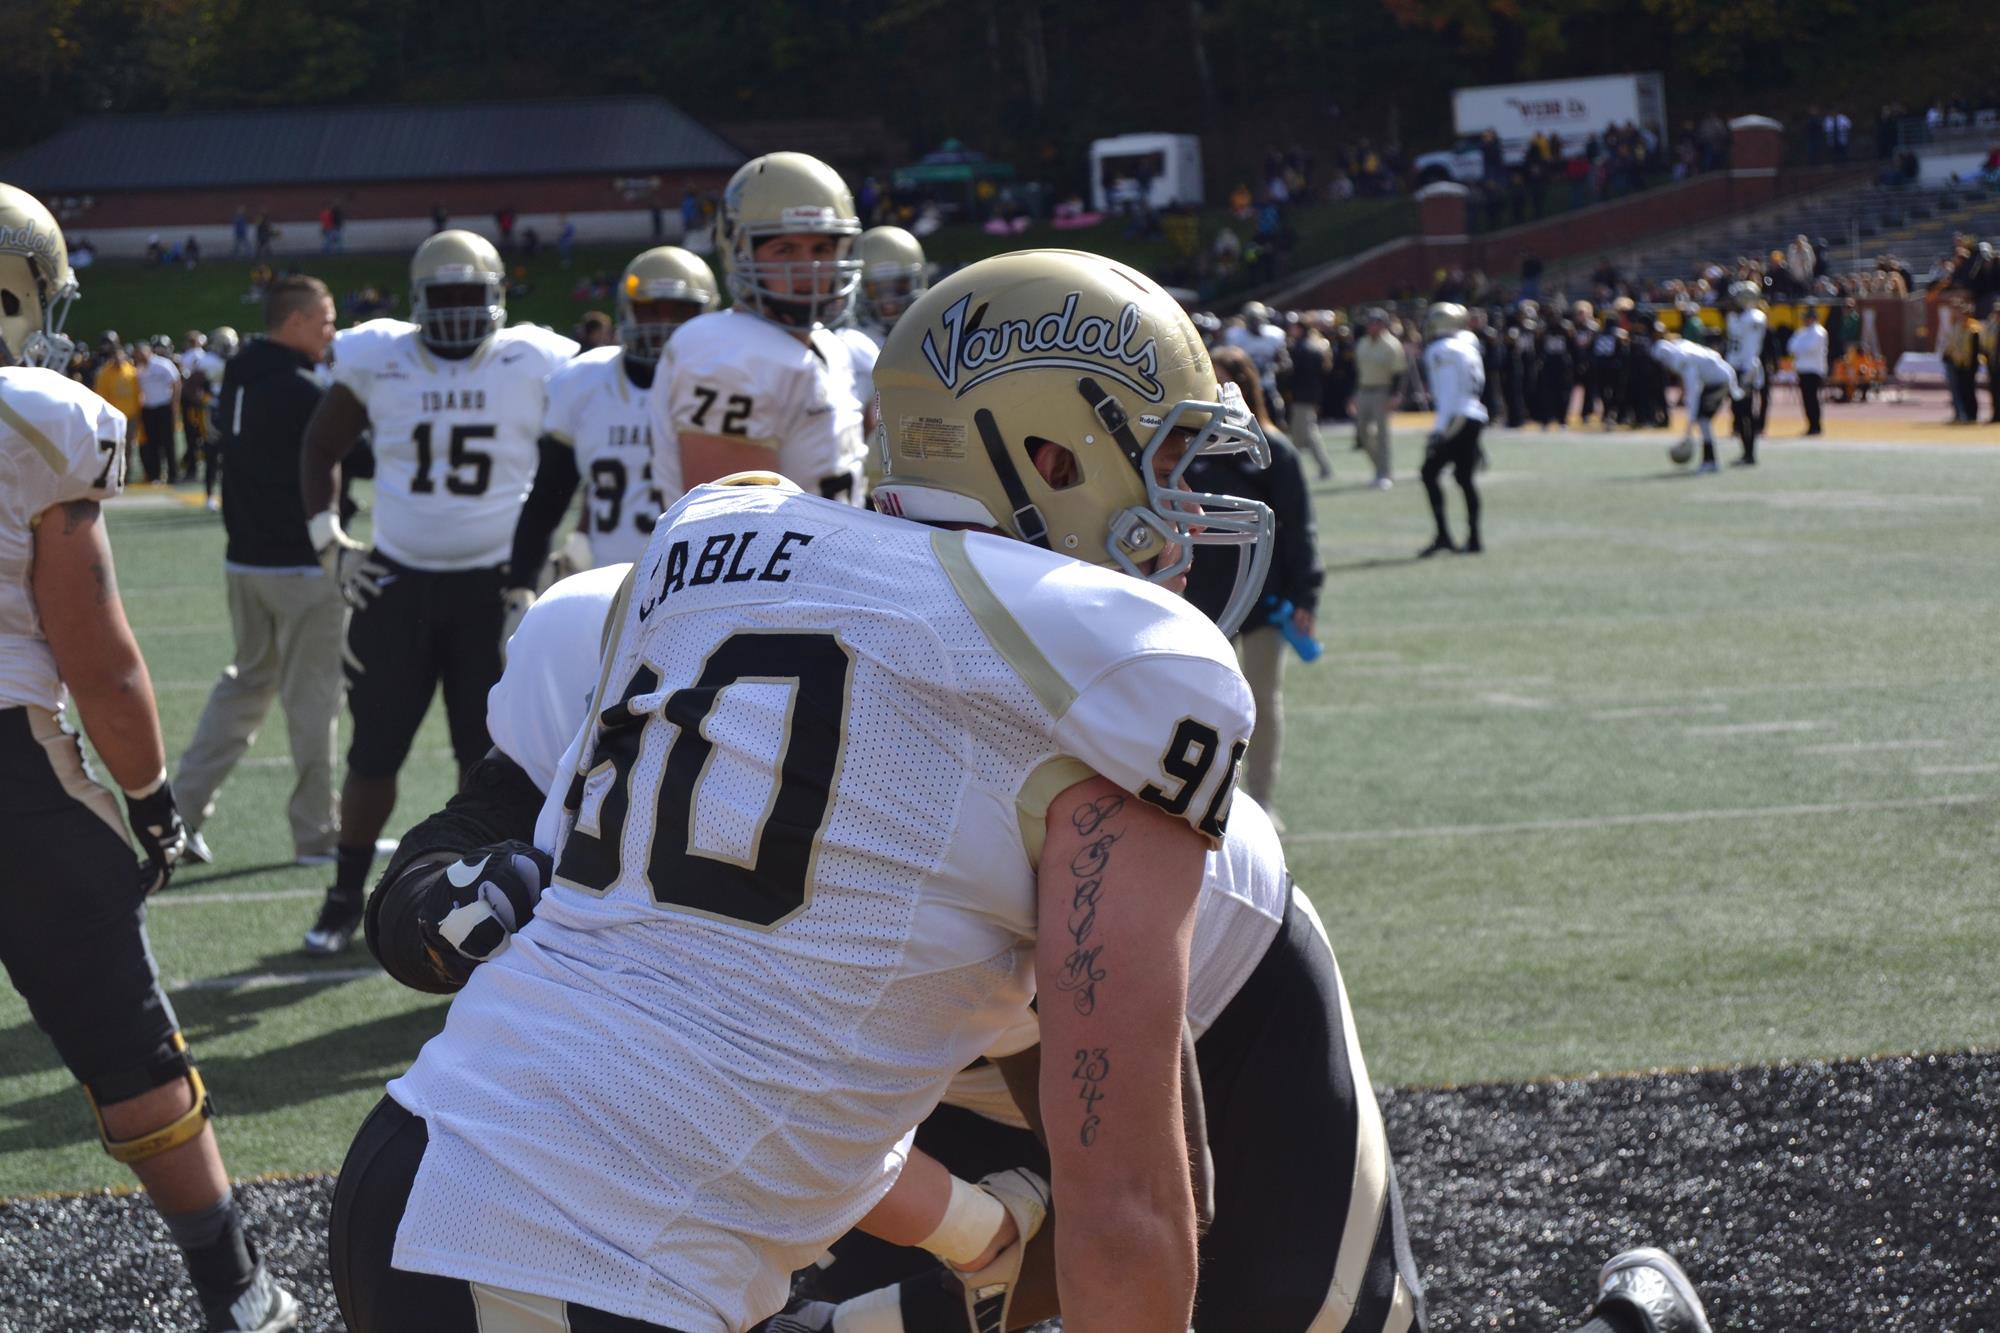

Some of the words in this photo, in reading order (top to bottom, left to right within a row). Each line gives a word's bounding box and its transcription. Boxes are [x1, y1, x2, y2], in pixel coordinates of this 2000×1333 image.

[921, 291, 1165, 404] Vandals
[422, 390, 486, 412] IDAHO
[691, 386, 753, 434] 72
[410, 421, 498, 497] 15
